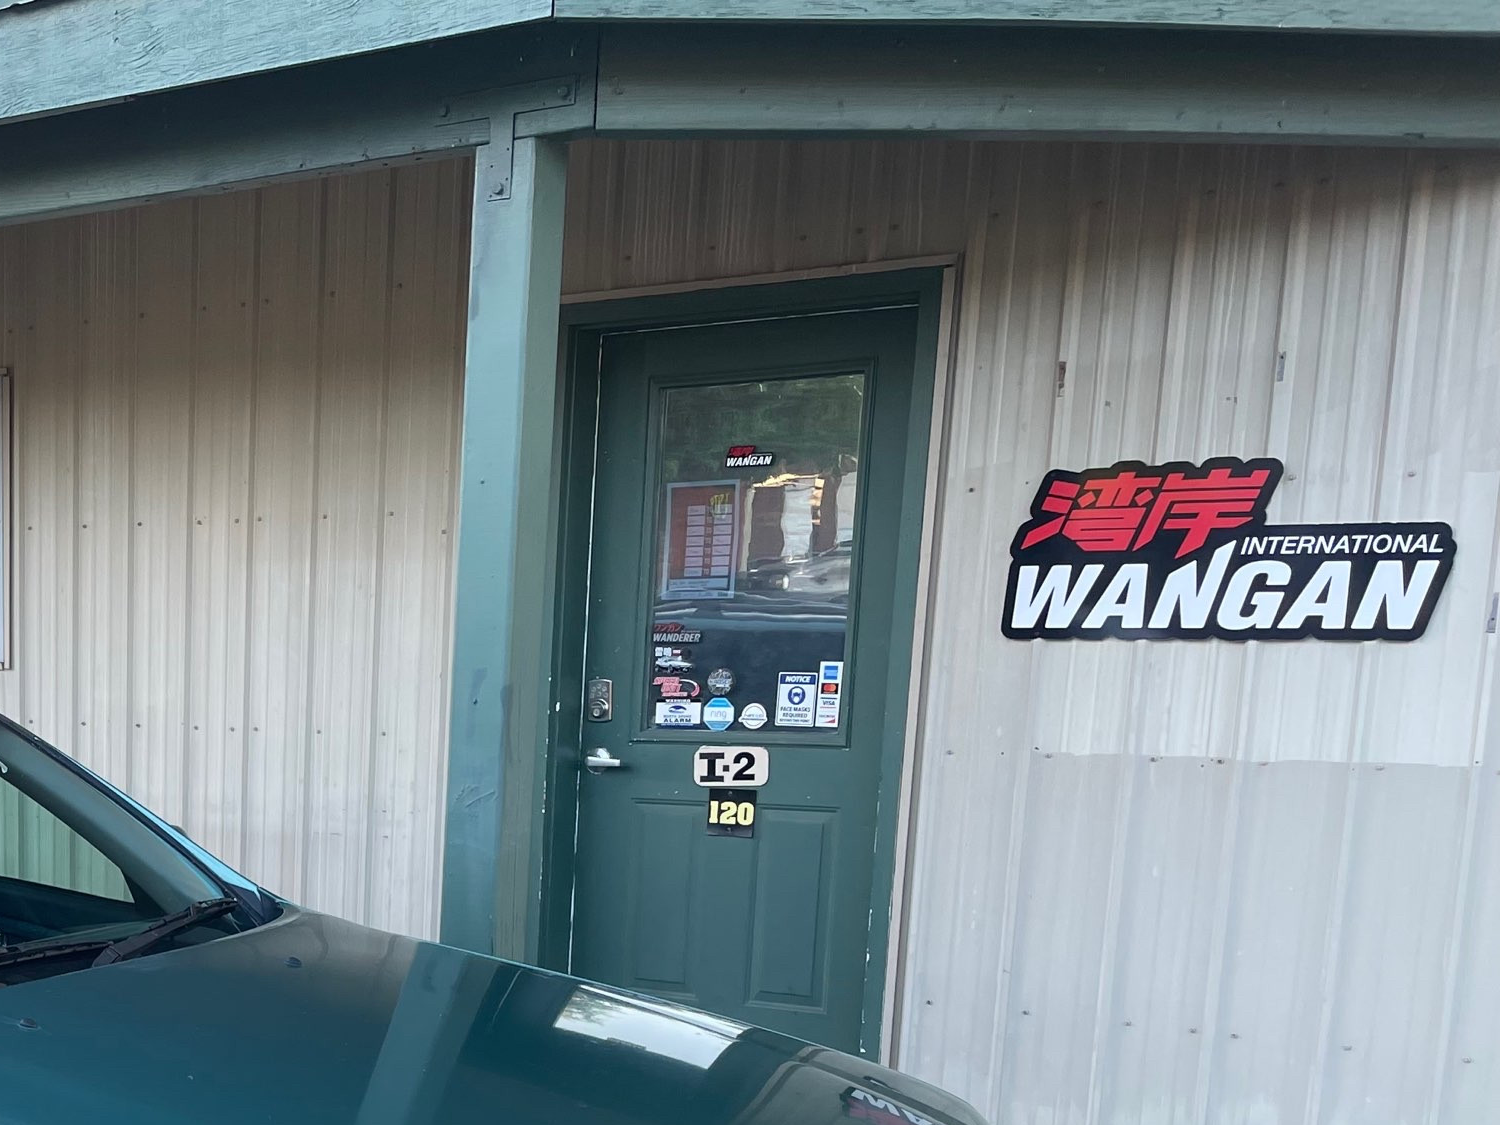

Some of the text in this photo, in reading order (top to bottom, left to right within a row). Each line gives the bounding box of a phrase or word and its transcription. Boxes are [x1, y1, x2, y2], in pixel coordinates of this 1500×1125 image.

[726, 455, 773, 467] WANGAN
[1020, 468, 1272, 560] 湾岸
[1240, 533, 1444, 557] INTERNATIONAL
[1010, 540, 1441, 631] WANGAN
[653, 633, 701, 643] WANDERER
[785, 675, 812, 683] NOTICE
[710, 710, 727, 720] ring
[708, 800, 755, 826] 120
